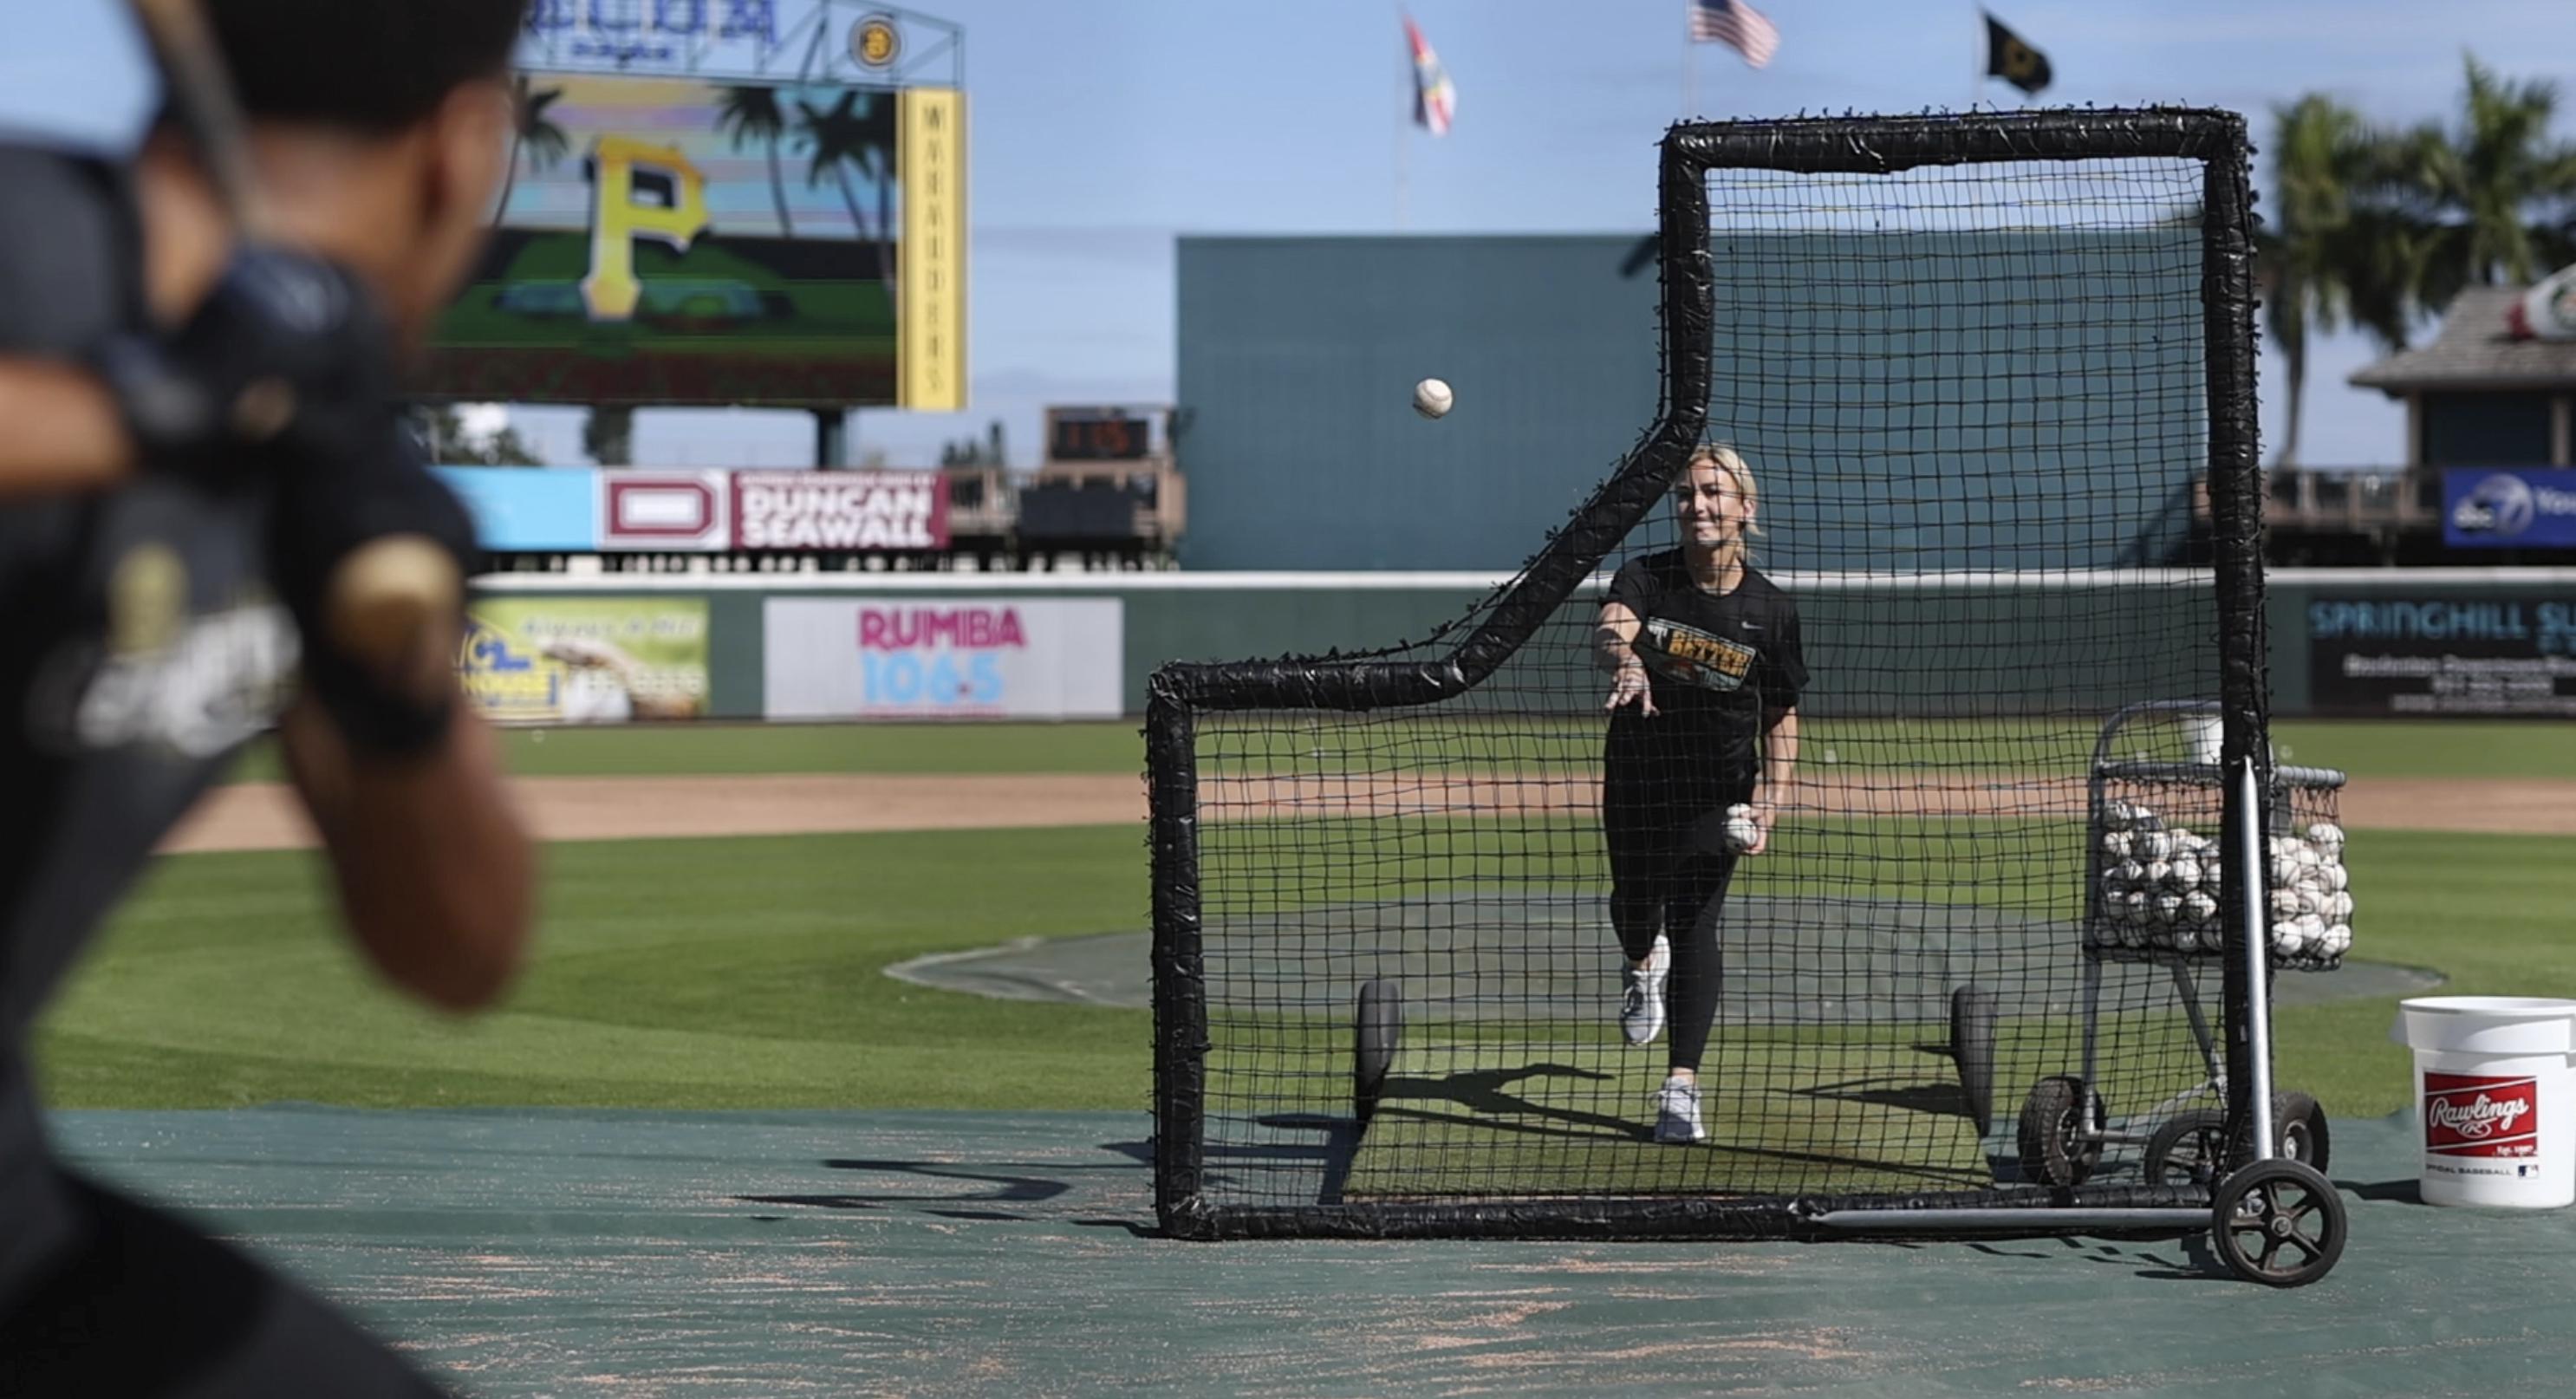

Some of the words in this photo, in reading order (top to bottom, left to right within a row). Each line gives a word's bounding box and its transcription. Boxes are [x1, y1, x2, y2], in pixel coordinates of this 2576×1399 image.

[579, 133, 713, 320] P
[741, 486, 935, 518] DUNCAN
[741, 517, 935, 549] SEAWALL
[860, 608, 1027, 650] RUMBA
[2309, 601, 2528, 640] SPRINGHILL
[862, 652, 1005, 704] 106.5
[2430, 1094, 2529, 1130] Rawlings
[2458, 1167, 2512, 1175] BASEBALL
